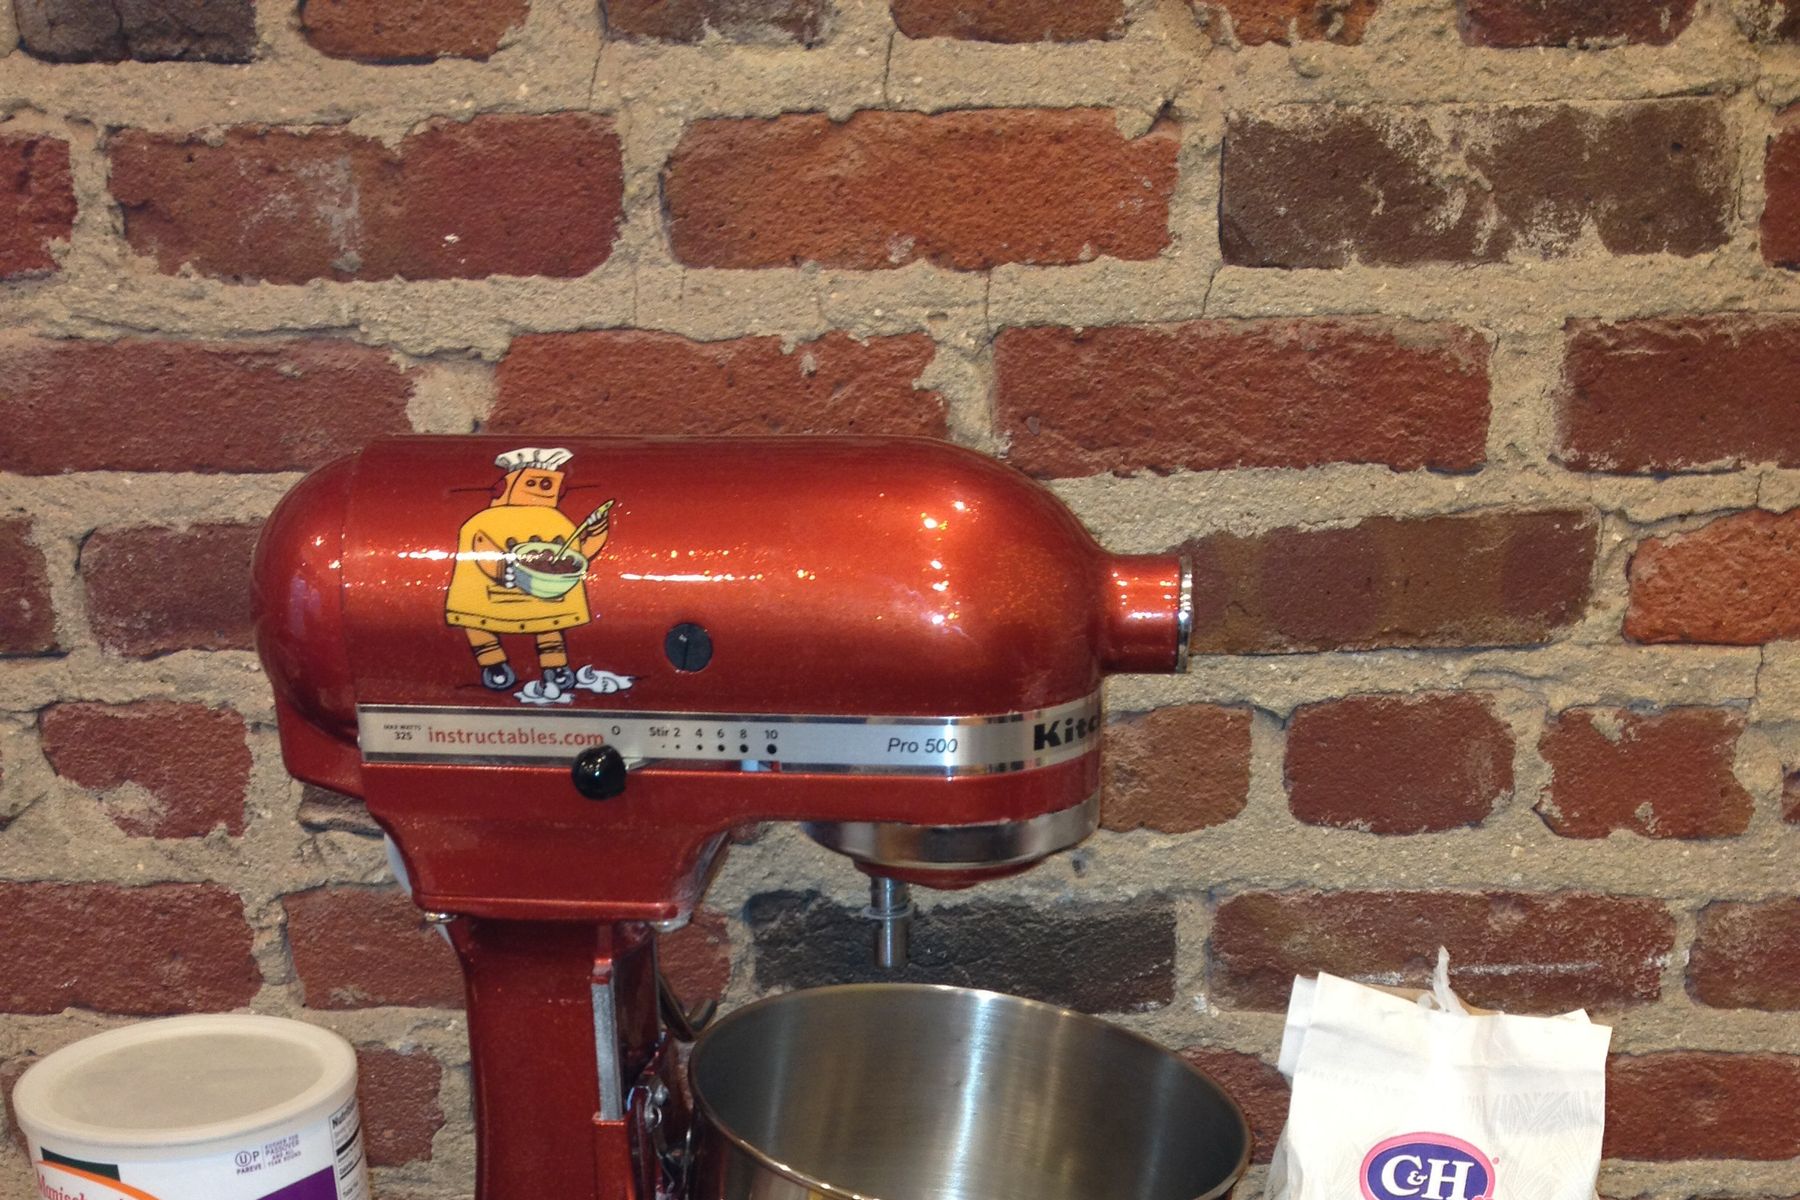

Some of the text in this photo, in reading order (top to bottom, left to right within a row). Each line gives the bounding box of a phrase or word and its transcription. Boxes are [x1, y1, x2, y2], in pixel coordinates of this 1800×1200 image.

[394, 731, 413, 741] 325
[428, 726, 605, 747] instructables.com
[649, 726, 669, 737] Stir
[673, 727, 681, 737] 2
[695, 727, 703, 737] 4
[717, 728, 725, 739] 6
[739, 728, 748, 739] 8
[765, 729, 779, 740] 10
[887, 736, 958, 753] Pro 500
